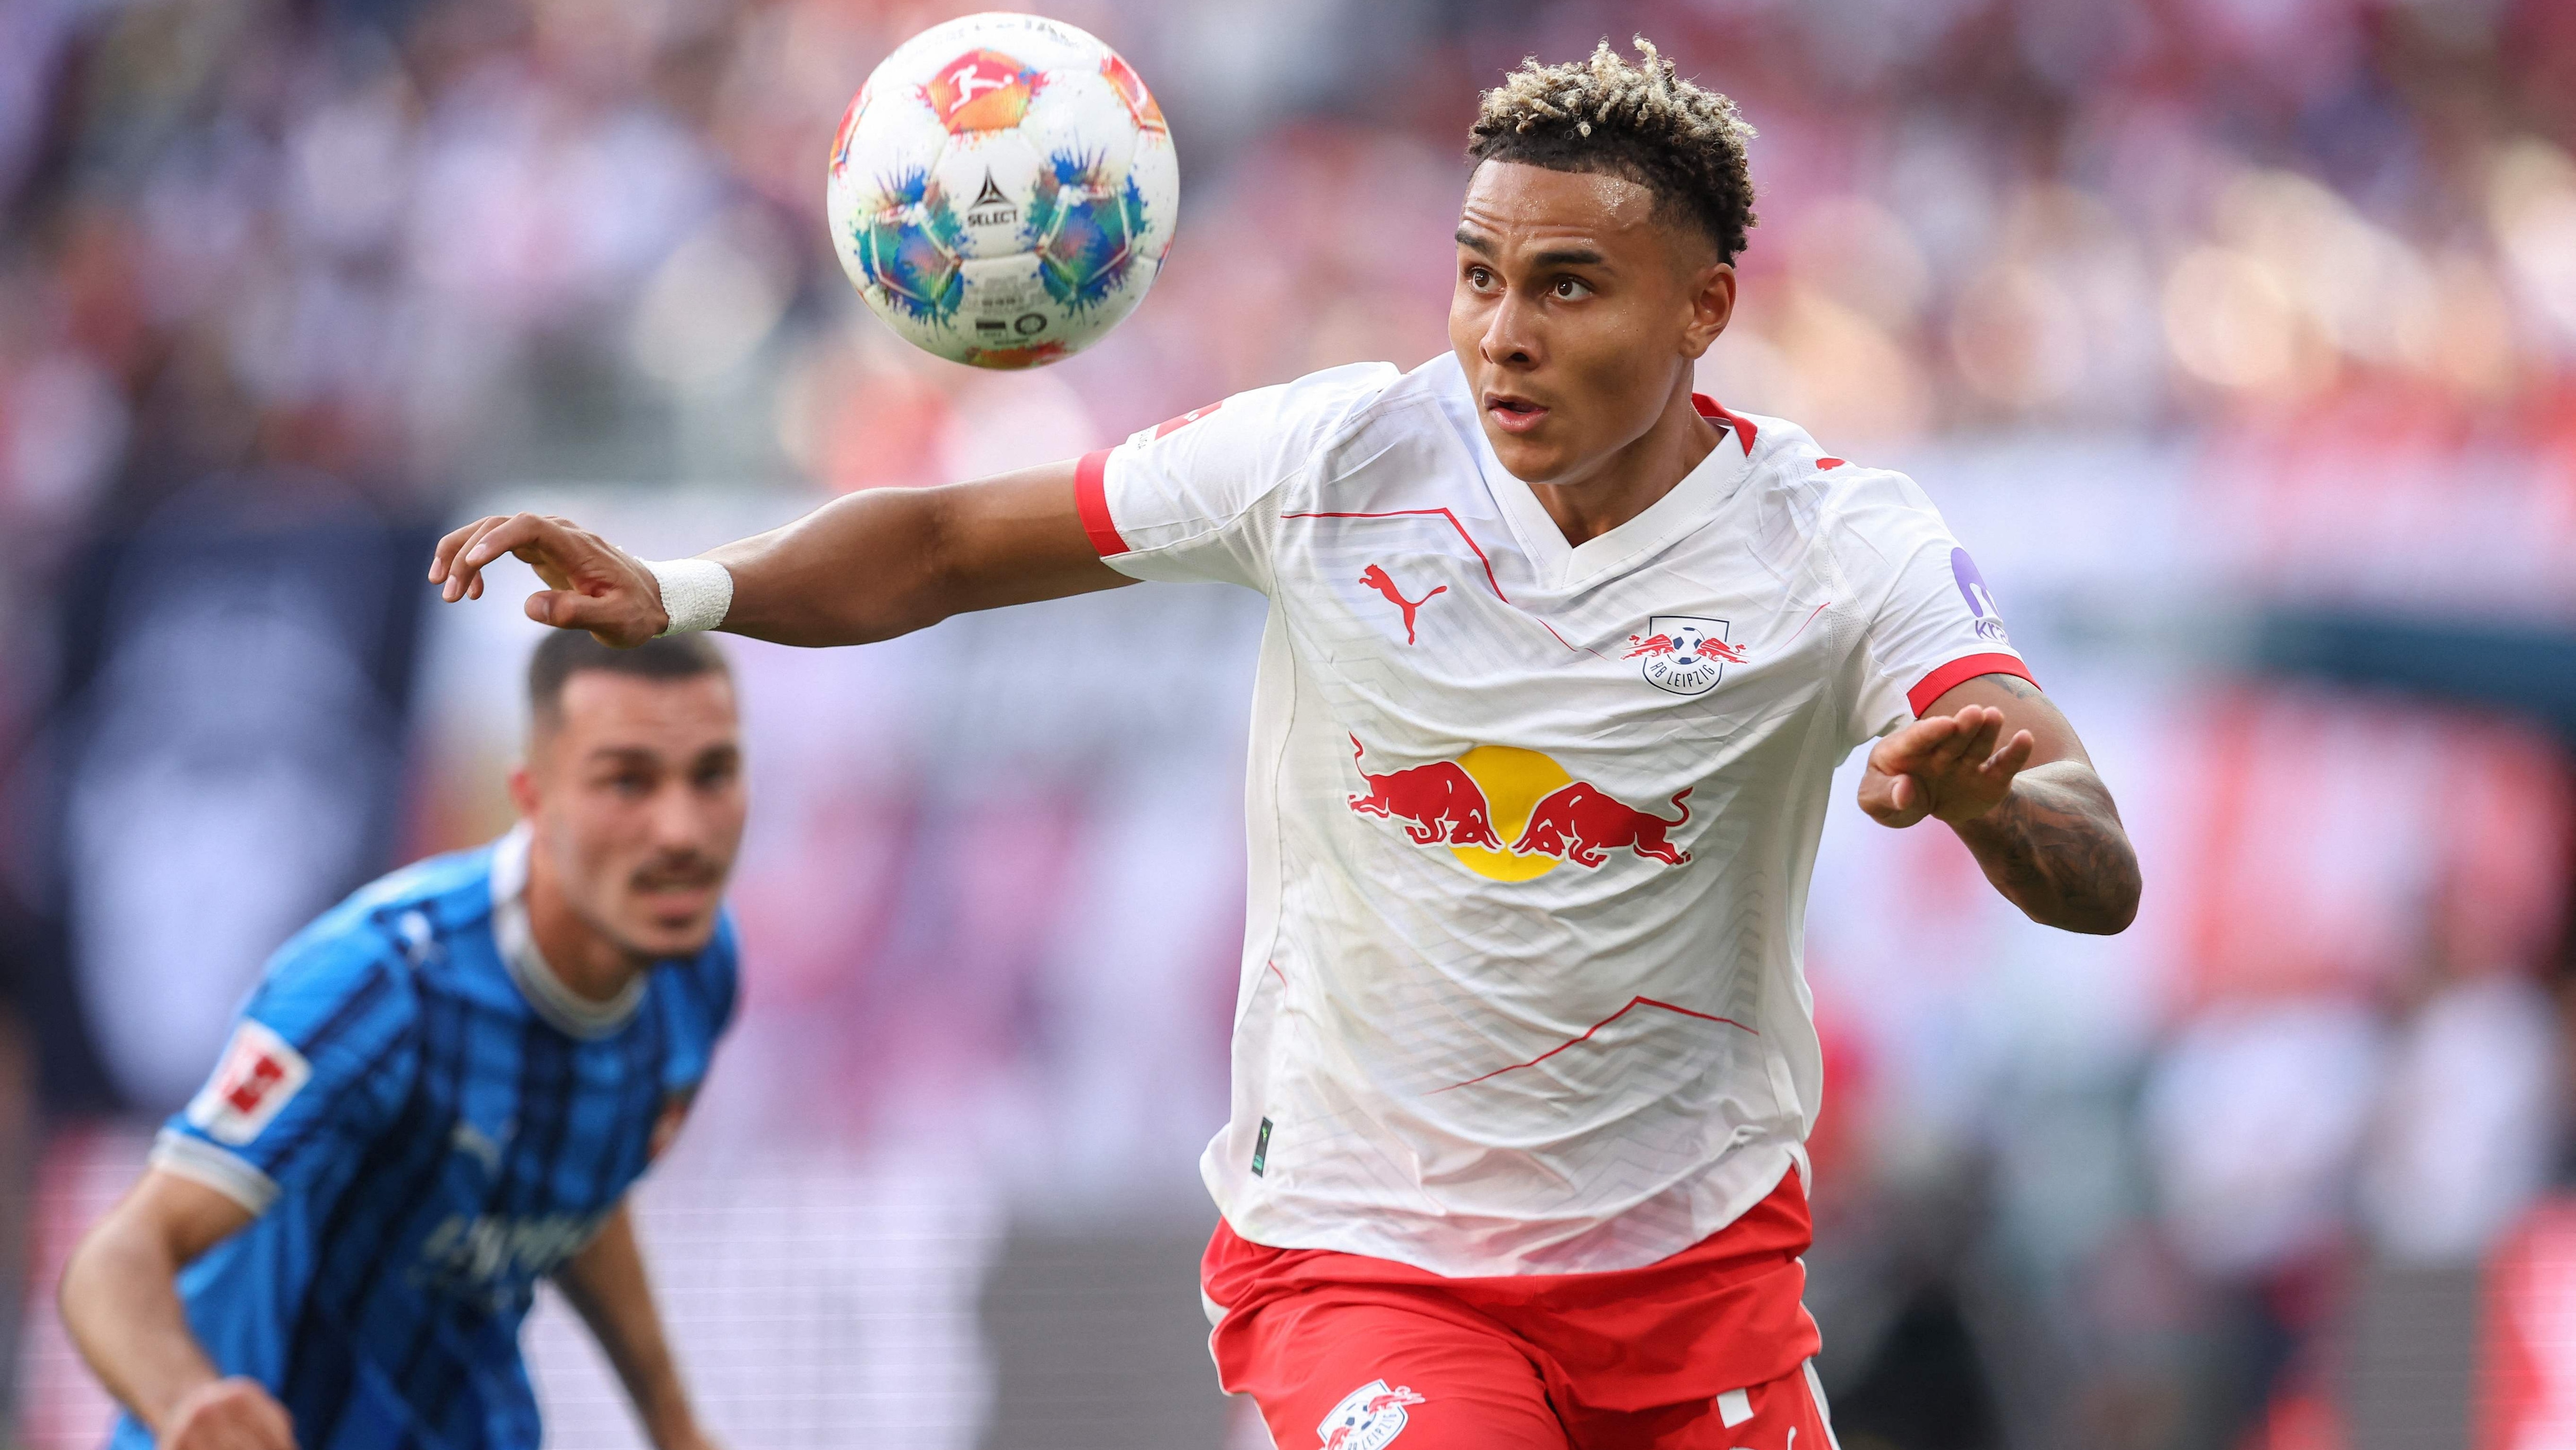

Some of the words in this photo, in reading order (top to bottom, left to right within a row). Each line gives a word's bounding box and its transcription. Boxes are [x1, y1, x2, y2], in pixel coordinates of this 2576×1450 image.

[967, 209, 1018, 227] SELECT
[1650, 661, 1667, 678] RB
[1667, 664, 1715, 688] LEIPZIG
